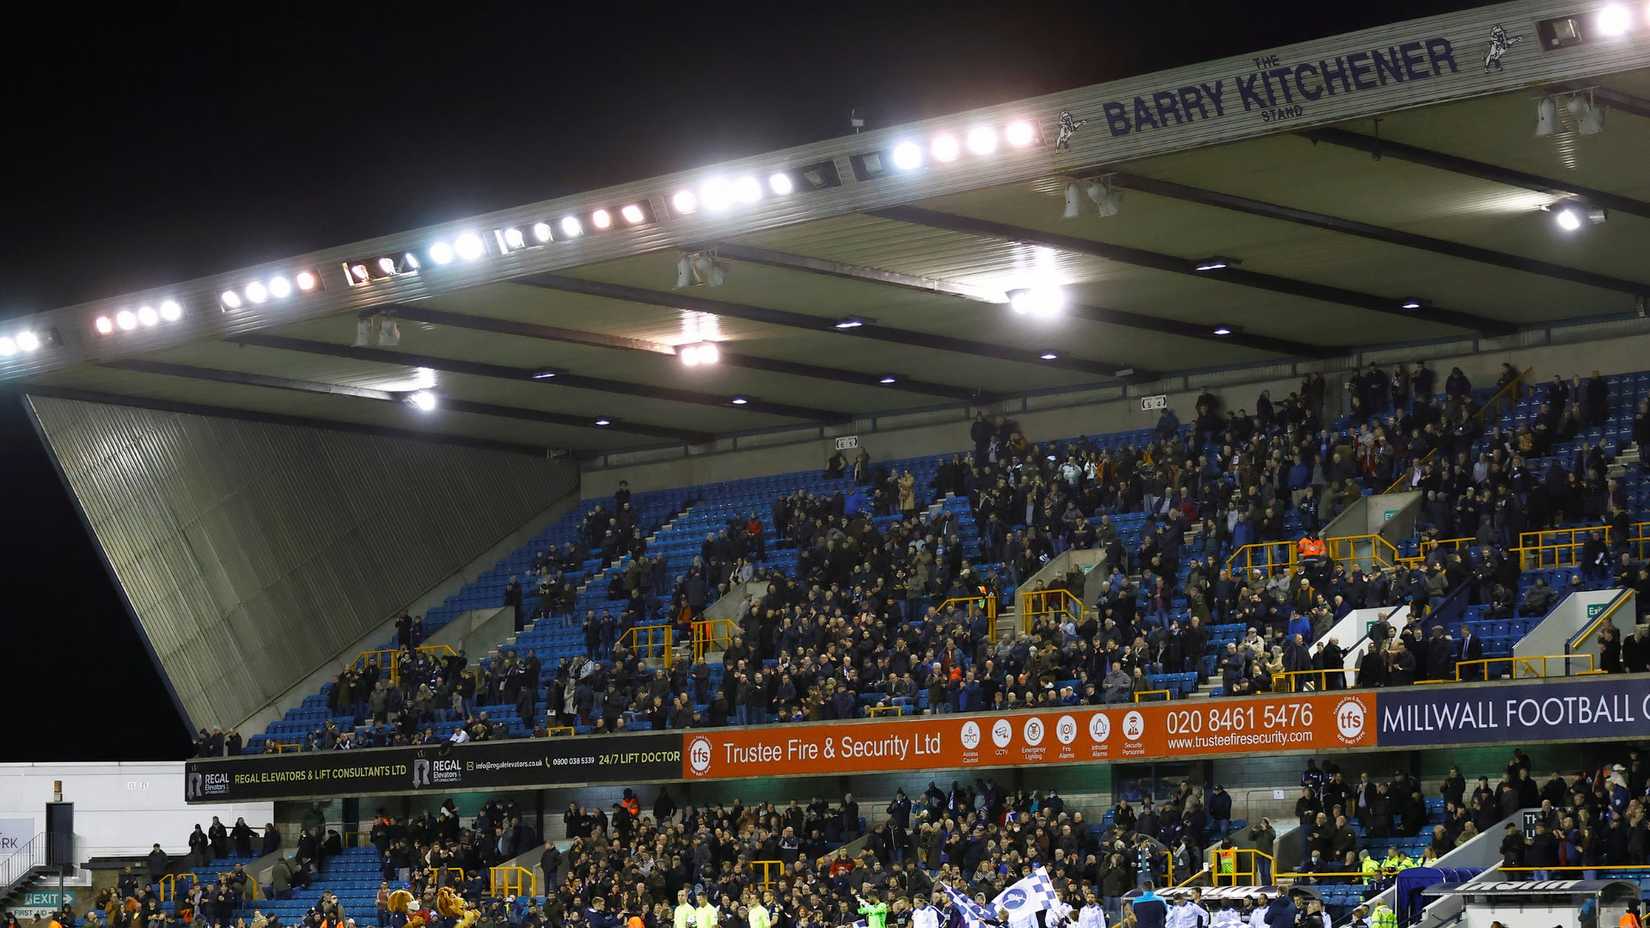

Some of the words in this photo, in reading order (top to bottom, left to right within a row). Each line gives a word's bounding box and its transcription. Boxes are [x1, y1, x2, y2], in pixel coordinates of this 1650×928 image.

[1253, 55, 1279, 69] THE
[1102, 80, 1224, 137] BARRY
[1235, 37, 1459, 112] KITCHENER
[1261, 105, 1303, 122] STAND
[1166, 710, 1202, 734] 020
[1208, 706, 1255, 732] 8461
[1263, 703, 1313, 728] 5476
[1341, 711, 1360, 728] tfs
[1383, 701, 1498, 733] MILLWALL
[1506, 694, 1635, 727] FOOTBALL
[1167, 730, 1313, 749] www.trusteefiresecurity.com
[693, 748, 708, 763] tfs
[723, 742, 782, 764] Trustee
[788, 739, 818, 760] Fire
[824, 737, 836, 759] &
[841, 733, 909, 760] Security
[915, 732, 941, 755] Ltd
[475, 759, 543, 771] info@regalelevators.co.uk
[599, 754, 619, 765] 24/7
[620, 753, 640, 764] LIFT
[641, 750, 681, 763] DOCTOR
[433, 760, 462, 771] REGAL
[204, 773, 230, 784] REGAL
[235, 772, 260, 784] REGAL
[261, 768, 306, 783] ELEVATORS
[307, 769, 313, 780] &
[315, 767, 331, 780] LIFT
[332, 764, 391, 779] CONSULTANTS
[391, 764, 407, 776] LTD
[433, 771, 457, 779] Elevators
[34, 893, 59, 905] EXIT
[14, 909, 33, 917] FIRST
